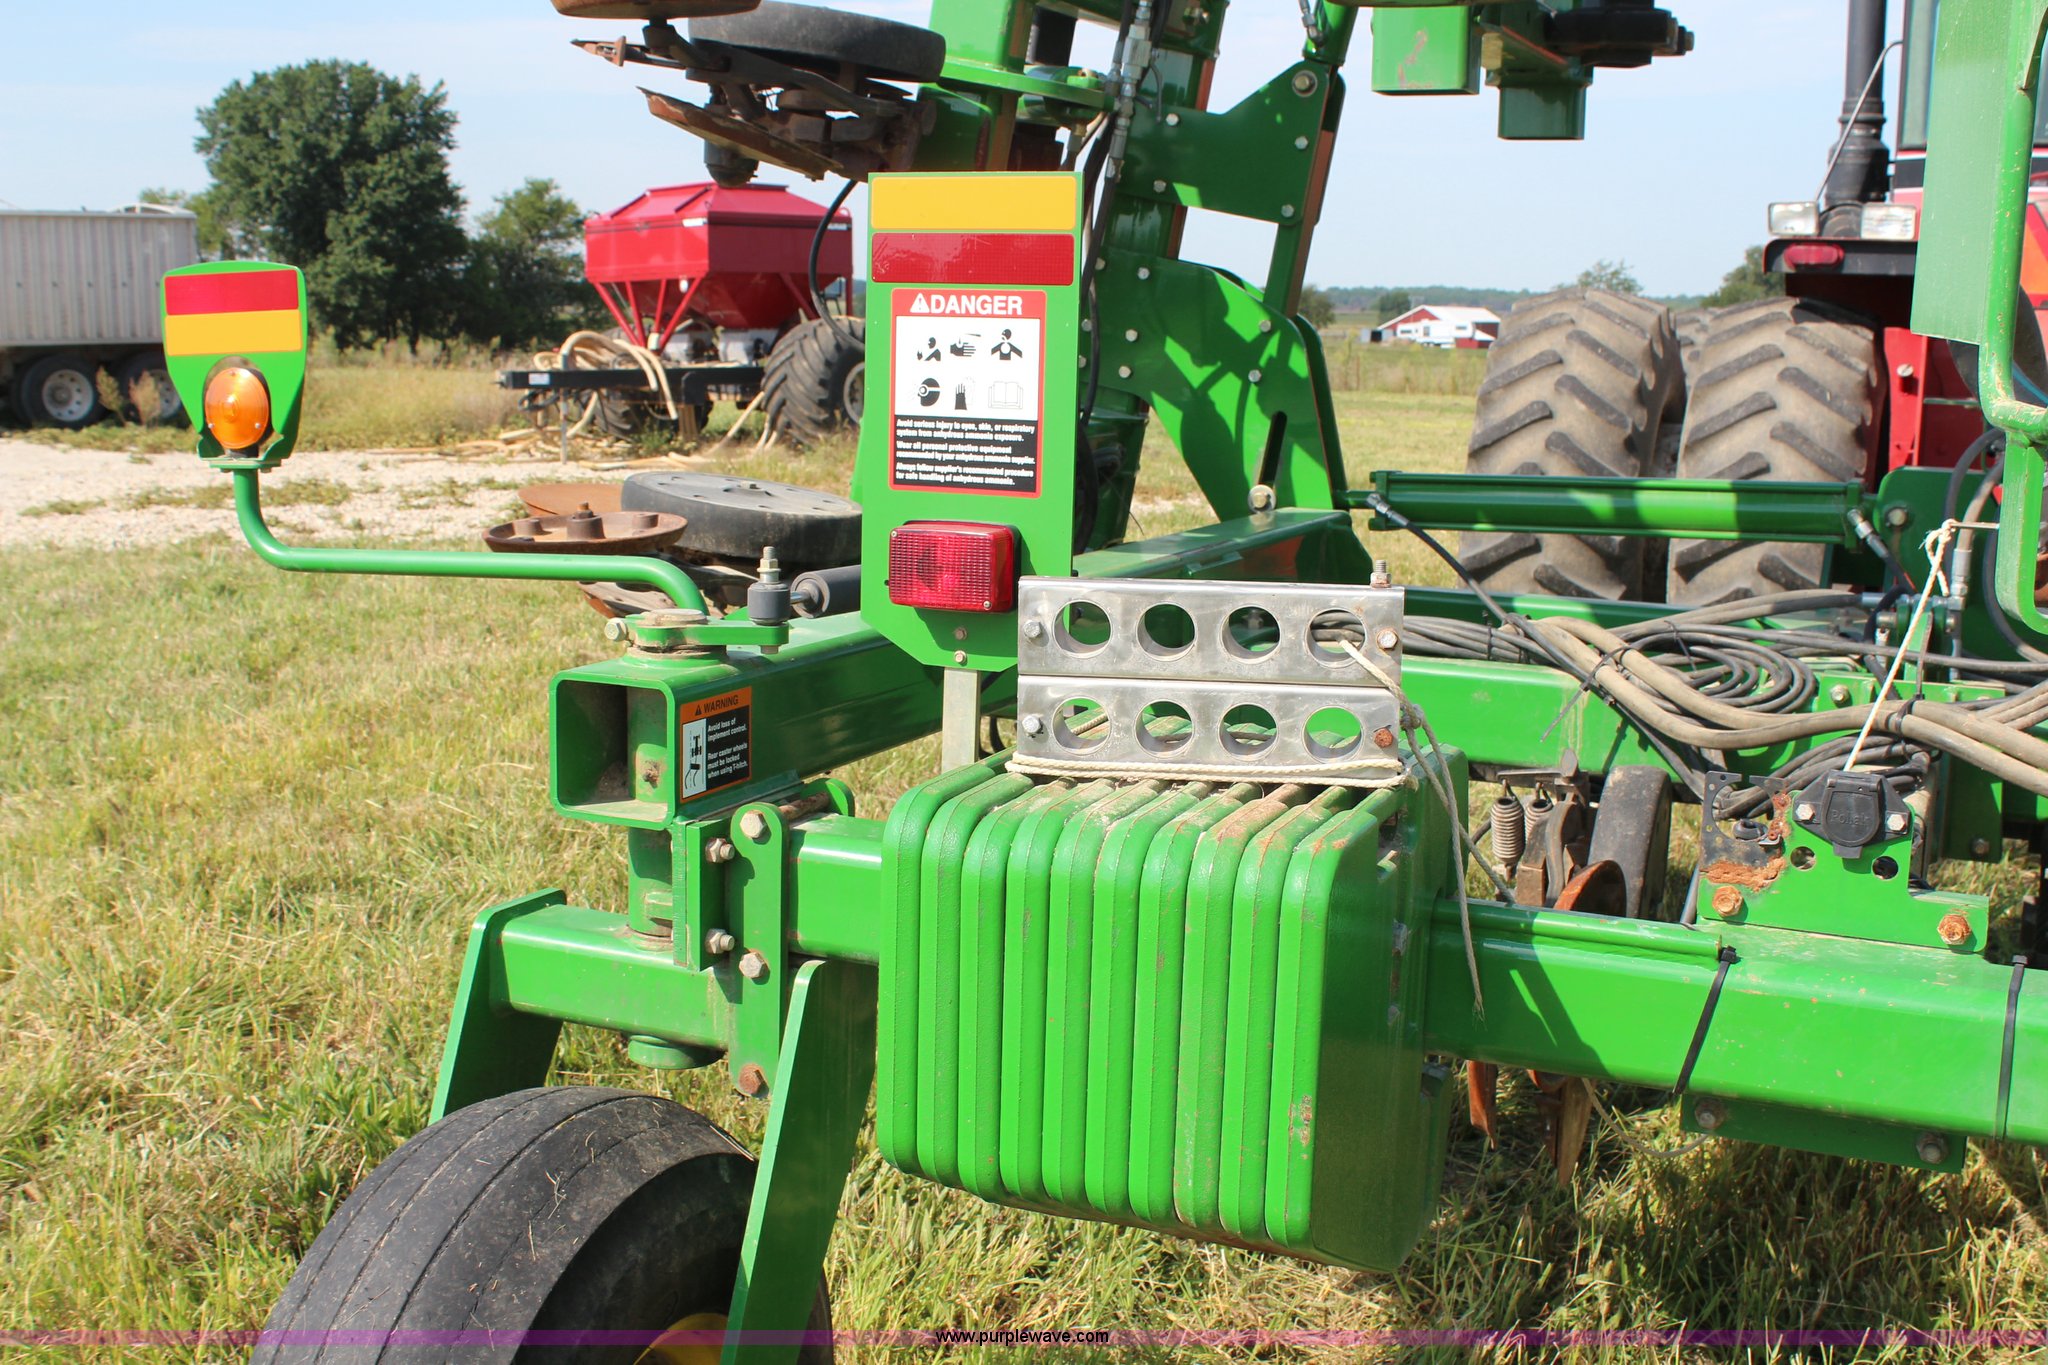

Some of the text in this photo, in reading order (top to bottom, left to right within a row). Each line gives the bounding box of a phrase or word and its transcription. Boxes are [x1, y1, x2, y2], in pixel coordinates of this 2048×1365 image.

[931, 294, 1022, 315] DANGER
[1002, 424, 1035, 434] respiratory
[704, 695, 738, 713] WARNING
[708, 722, 720, 732] Avoid
[708, 724, 747, 742] implement control.
[719, 748, 732, 756] caster
[733, 742, 747, 752] wheels
[708, 761, 718, 769] must
[726, 753, 740, 763] locked
